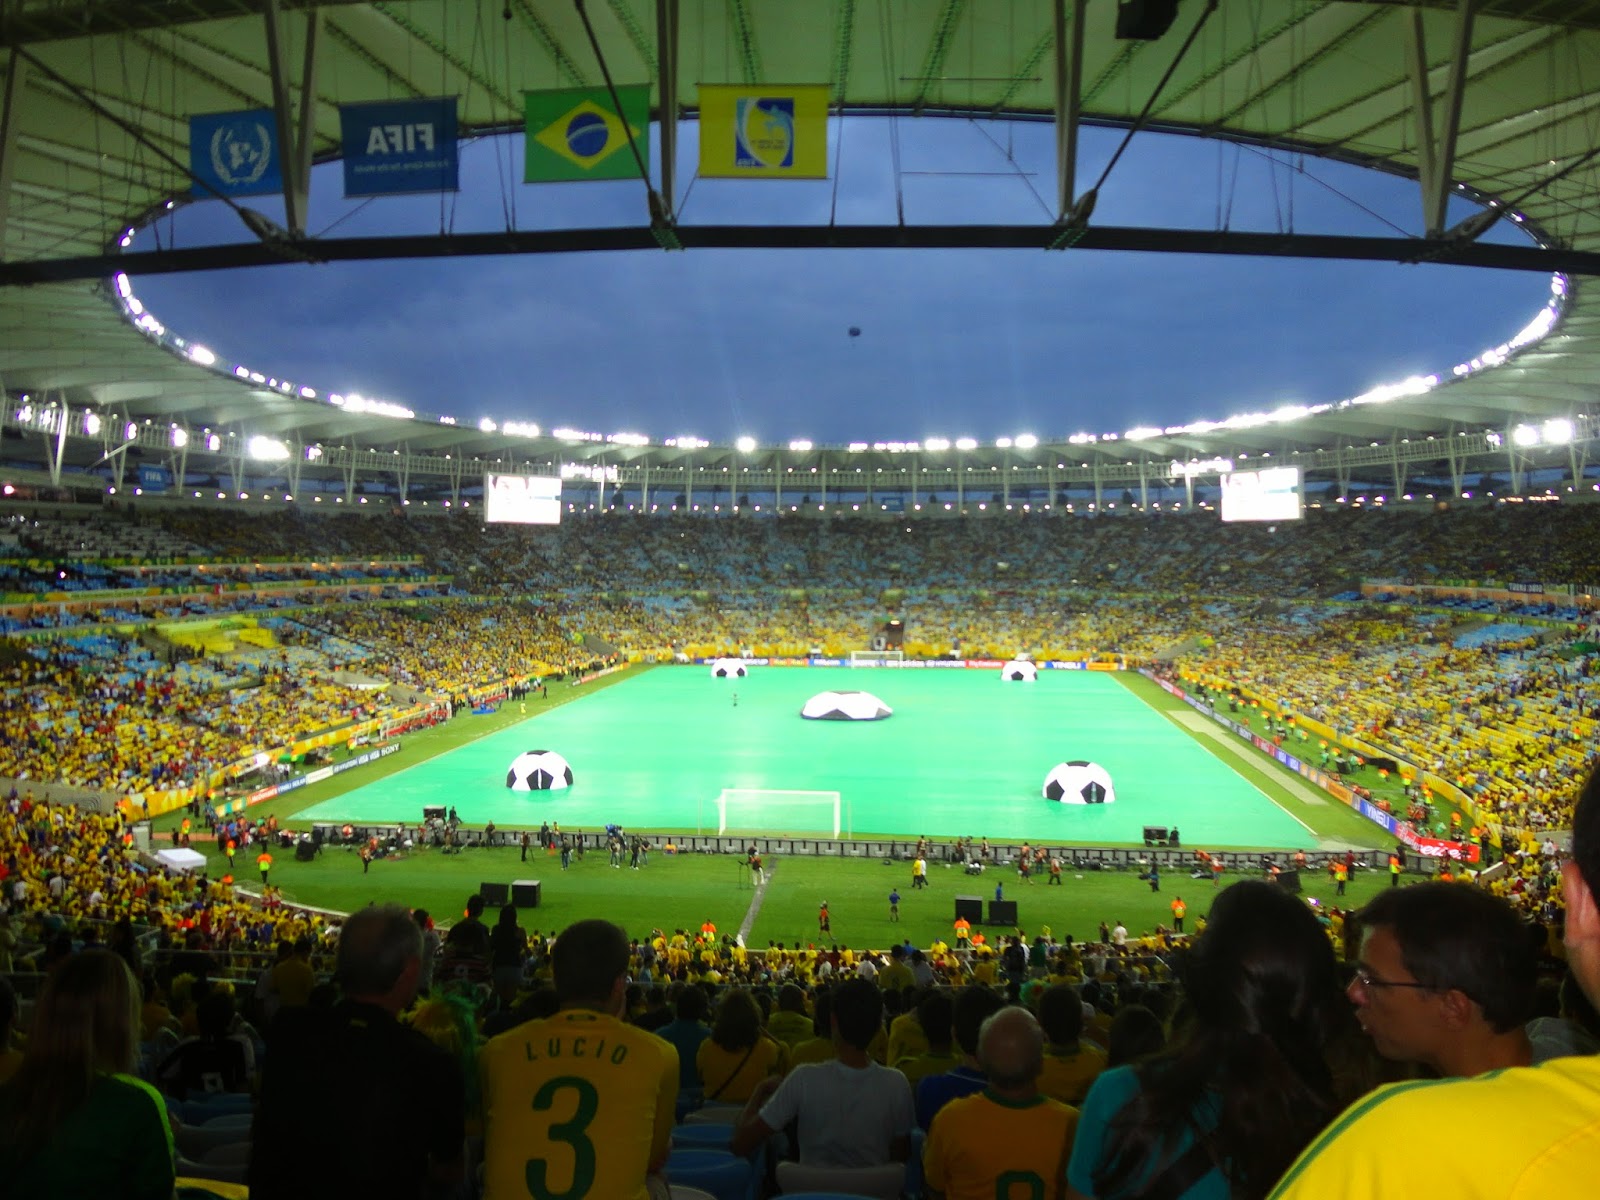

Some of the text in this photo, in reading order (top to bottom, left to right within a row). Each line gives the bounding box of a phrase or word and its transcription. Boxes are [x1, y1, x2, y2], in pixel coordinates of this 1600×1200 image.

[381, 742, 400, 757] SONY
[1366, 802, 1390, 829] YINGLI
[1399, 827, 1471, 860] Budweie
[525, 1036, 629, 1065] LUCIO
[525, 1076, 599, 1200] 3
